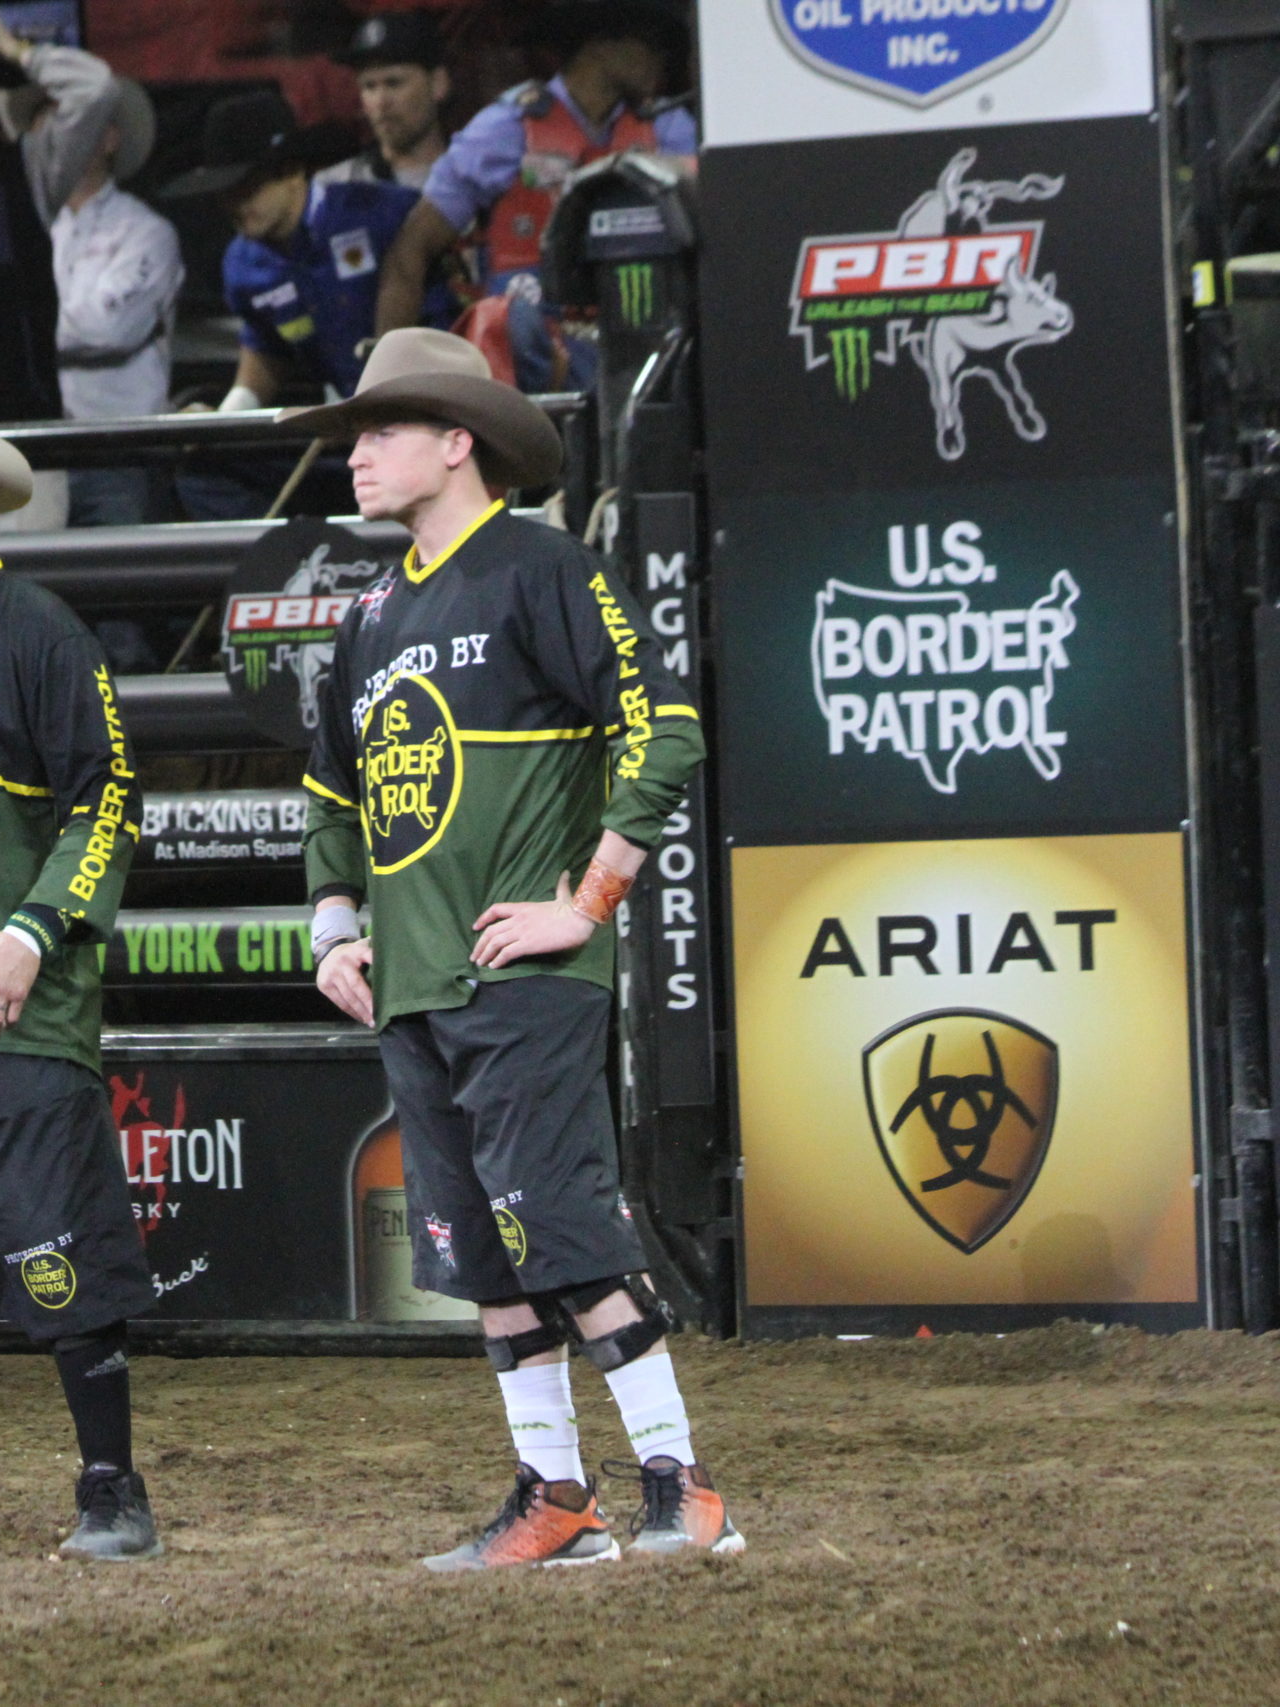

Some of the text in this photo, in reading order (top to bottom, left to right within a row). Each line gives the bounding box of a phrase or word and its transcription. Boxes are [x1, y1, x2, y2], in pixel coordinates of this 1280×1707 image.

[794, 0, 852, 30] OIL
[888, 32, 960, 68] INC.
[810, 234, 1023, 294] PBR
[888, 520, 997, 587] U.S.
[233, 596, 355, 629] PBR
[646, 551, 689, 677] MGM
[451, 634, 490, 668] BY
[822, 608, 1069, 679] BORDER
[828, 685, 1068, 755] PATROL
[68, 782, 128, 902] BORDER
[178, 840, 250, 859] Madison
[253, 838, 302, 860] Squar
[123, 920, 314, 974] YORK CITY
[799, 908, 1117, 979] ARIAT
[120, 1119, 243, 1189] LETON
[57, 1231, 73, 1247] BY
[131, 1202, 181, 1219] SKY
